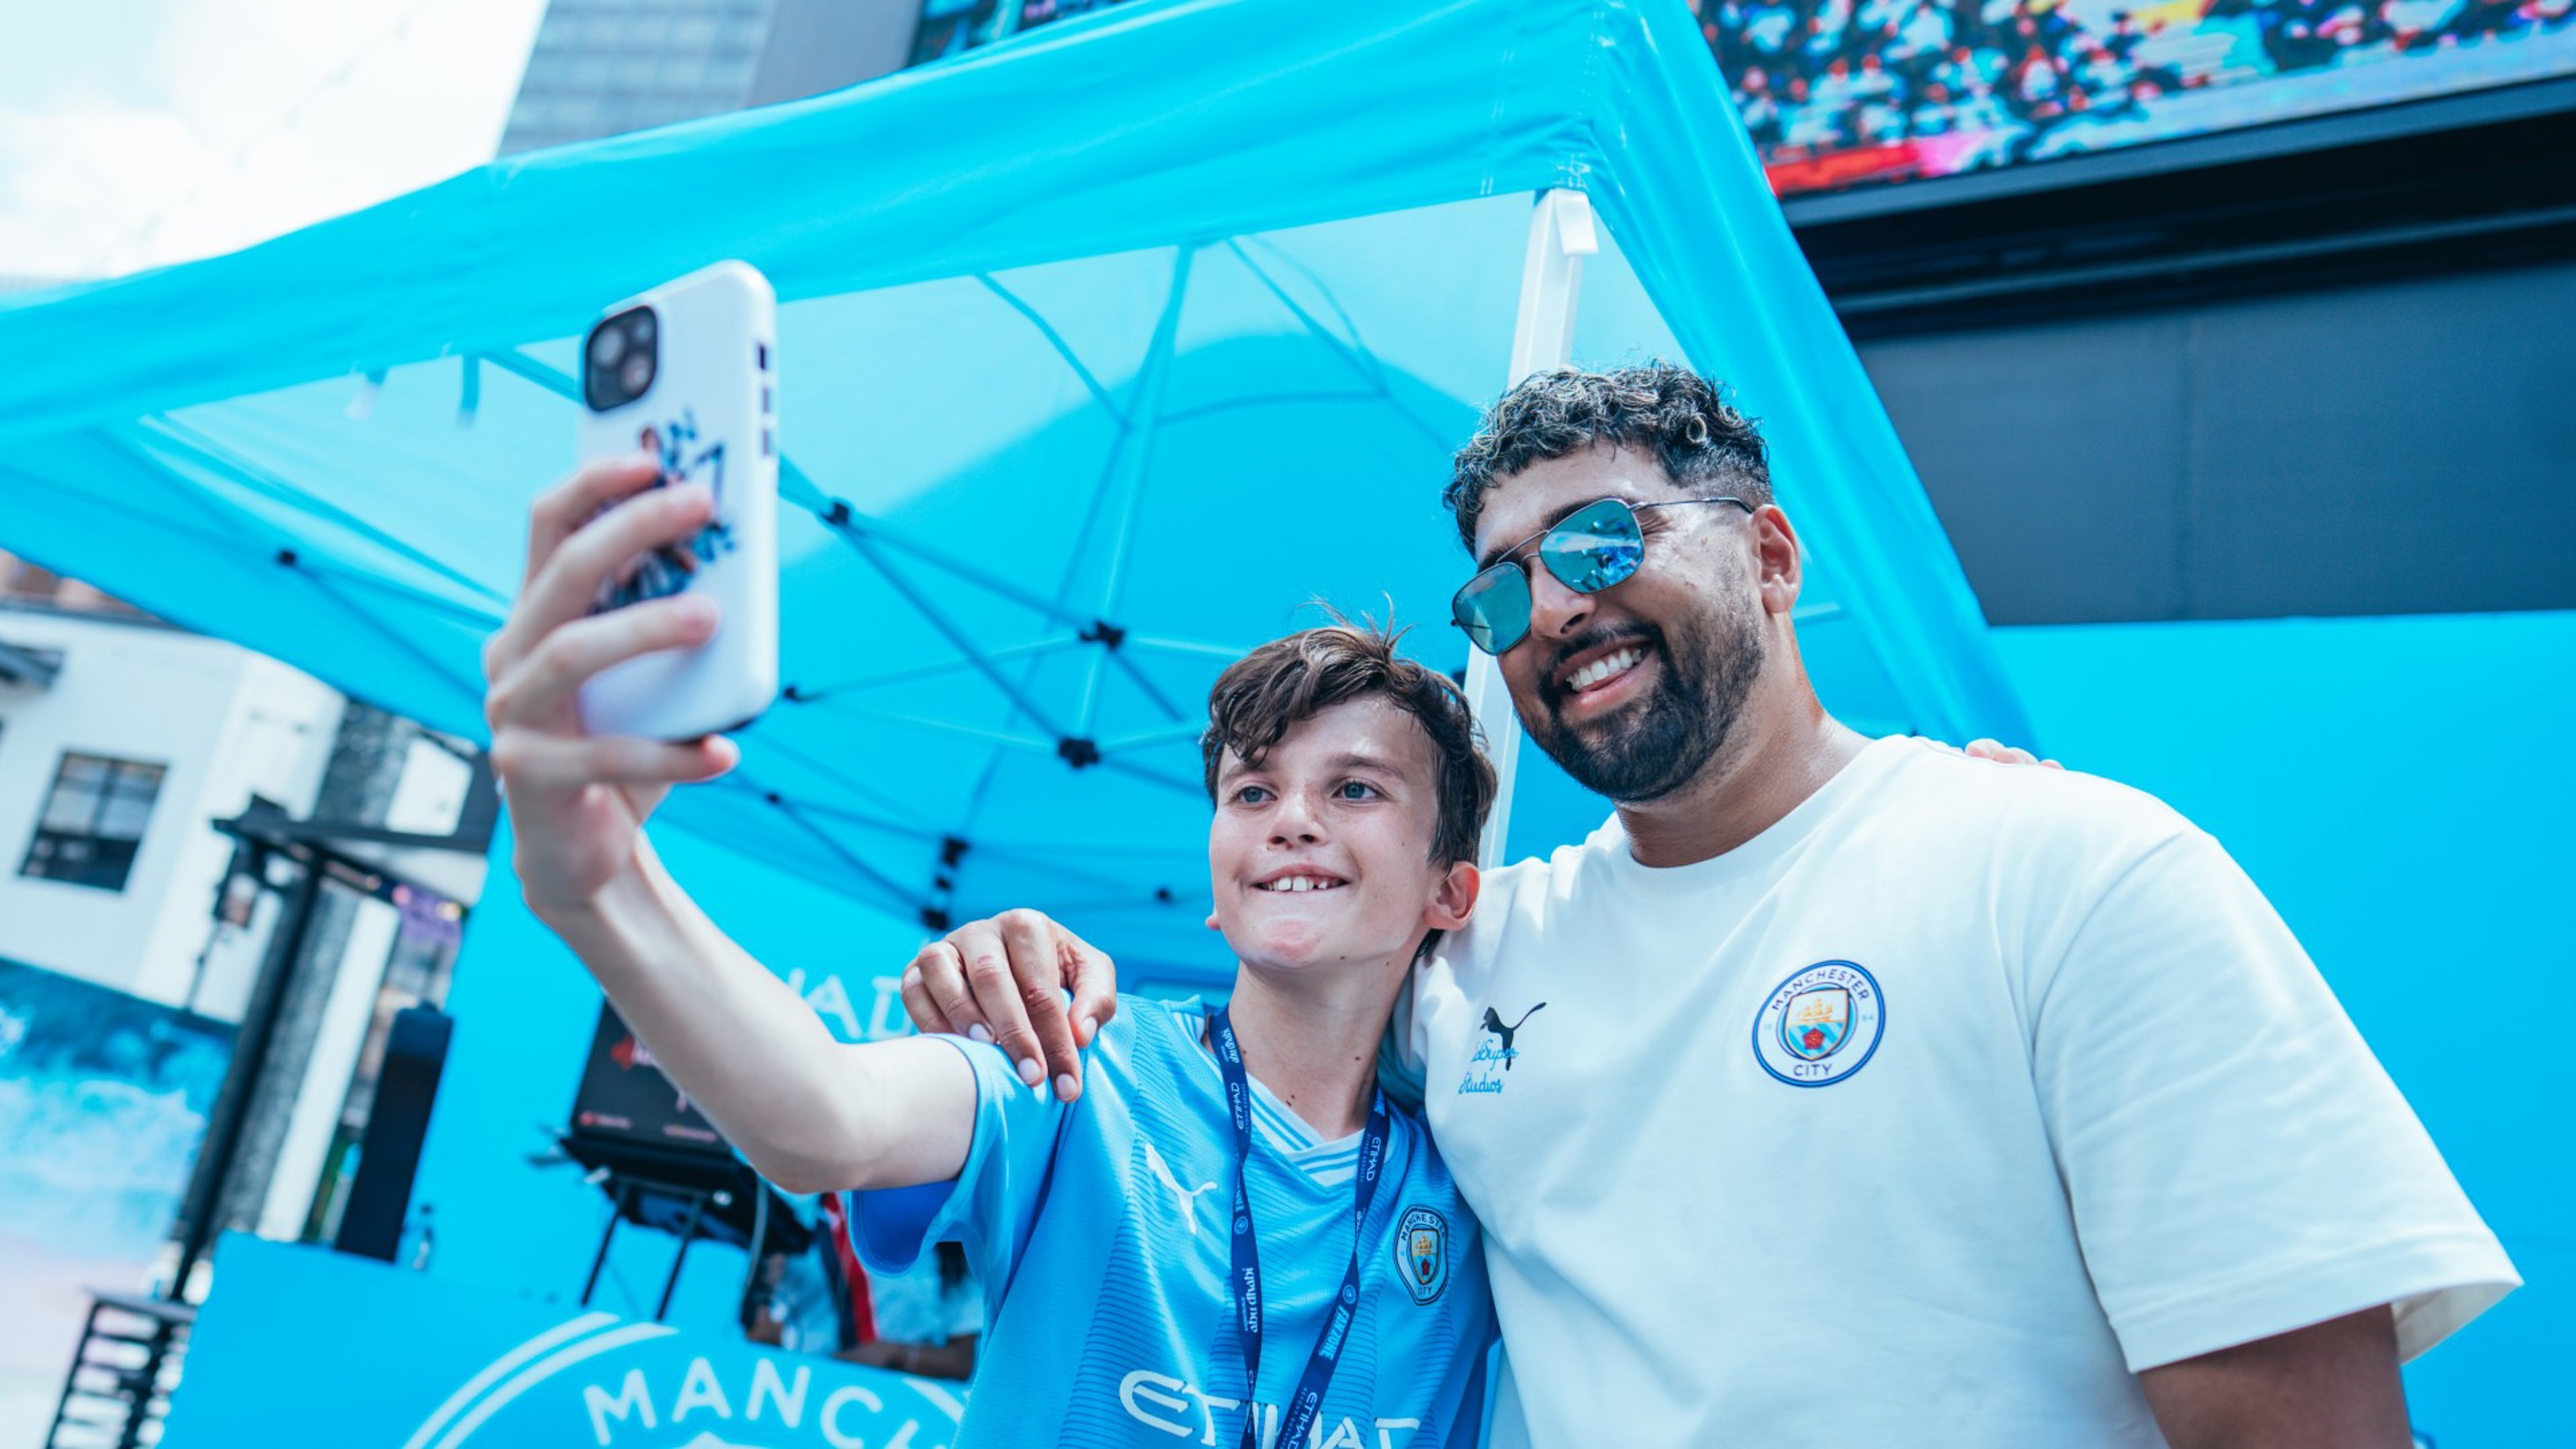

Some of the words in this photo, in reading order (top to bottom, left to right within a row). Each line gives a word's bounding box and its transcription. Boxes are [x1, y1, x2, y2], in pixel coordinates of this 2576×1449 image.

[1771, 969, 1870, 1011] MANCHESTER
[1793, 1063, 1833, 1077] CITY
[1231, 1081, 1245, 1131] ETIHAD
[1366, 1136, 1381, 1182] ETIHAD
[1241, 1267, 1256, 1306] dhabi
[1248, 1306, 1258, 1333] abu
